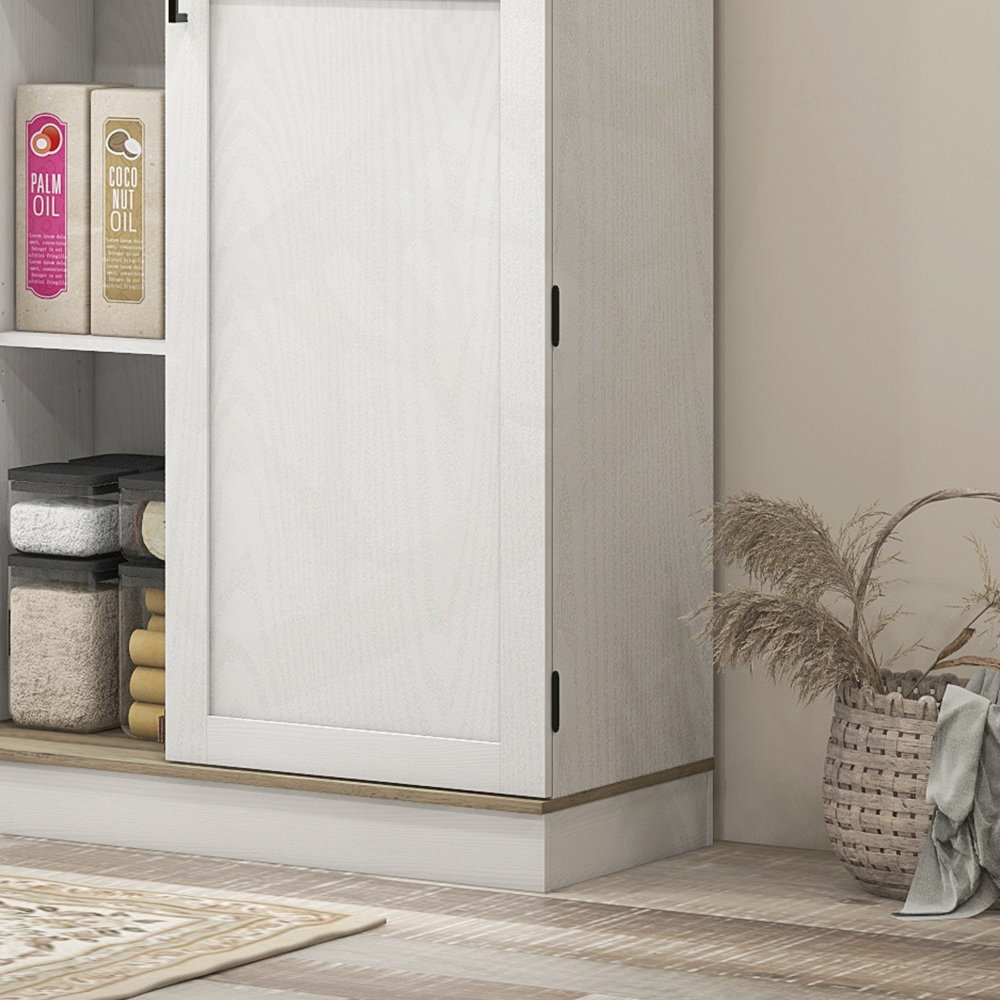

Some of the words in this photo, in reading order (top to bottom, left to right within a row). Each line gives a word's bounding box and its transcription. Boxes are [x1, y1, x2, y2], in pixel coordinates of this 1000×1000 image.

[31, 172, 61, 194] PALM
[109, 166, 138, 188] COCO
[33, 195, 60, 217] OIL
[112, 188, 135, 210] NUT
[110, 210, 137, 233] OIL
